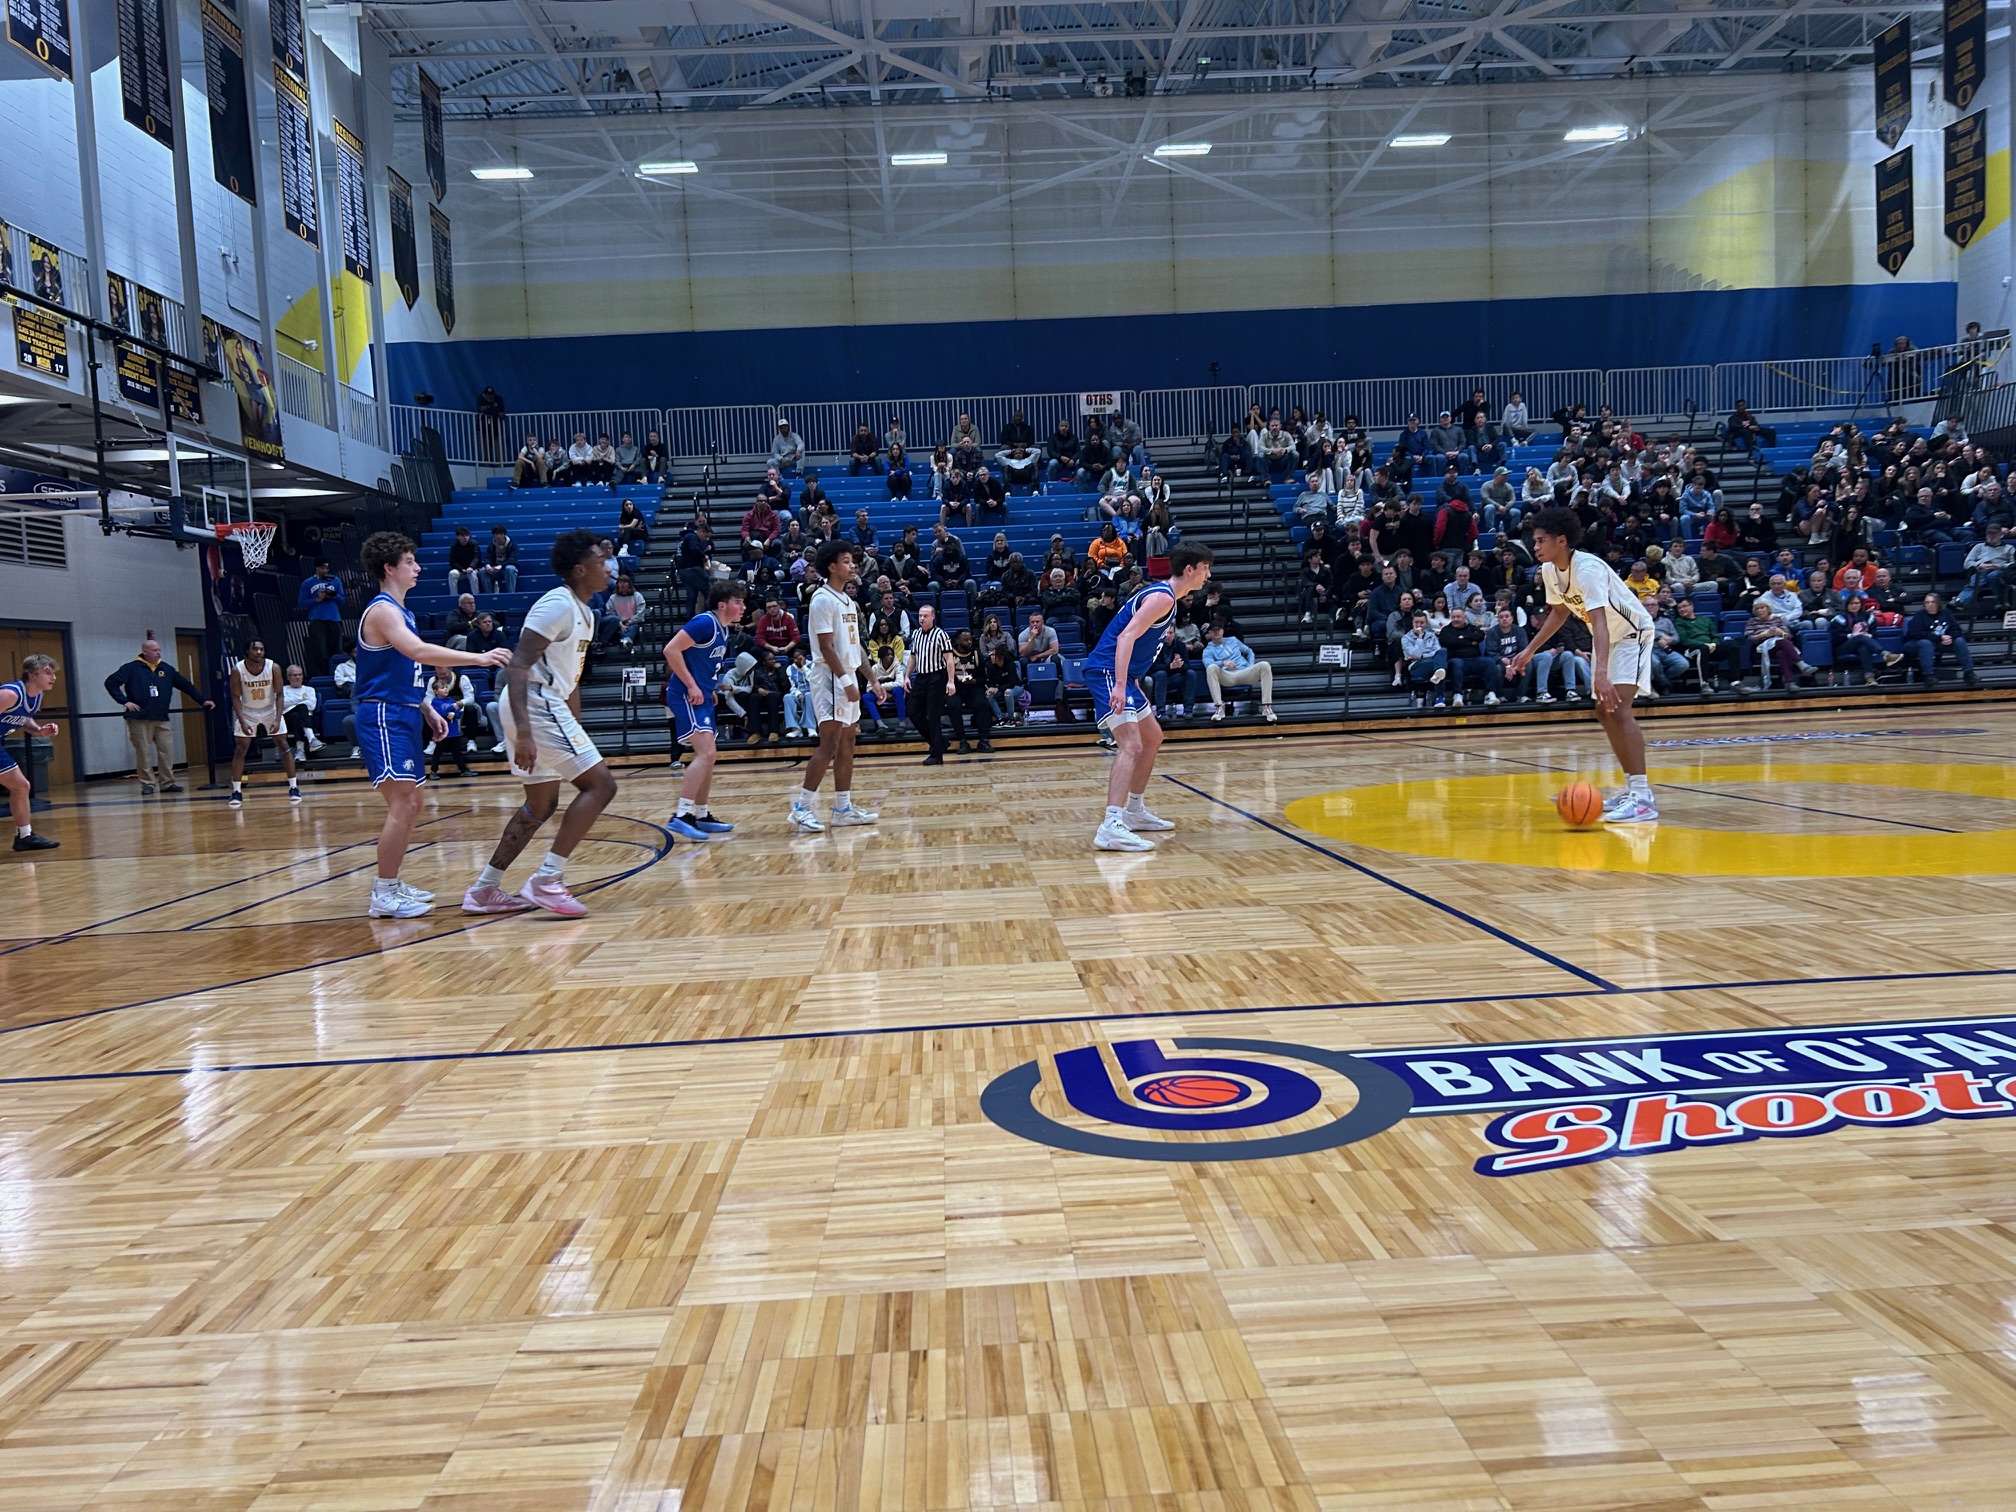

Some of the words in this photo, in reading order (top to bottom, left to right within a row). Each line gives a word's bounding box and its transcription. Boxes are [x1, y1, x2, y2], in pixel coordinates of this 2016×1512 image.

[275, 65, 307, 104] REGIONAL
[335, 121, 363, 155] REGIONAL
[55, 364, 64, 374] 17
[1086, 394, 1113, 406] OTHS
[251, 689, 265, 701] 10
[1406, 1048, 1723, 1097] BANK
[1703, 1050, 1789, 1074] OF
[1492, 1070, 2016, 1171] Shoot
